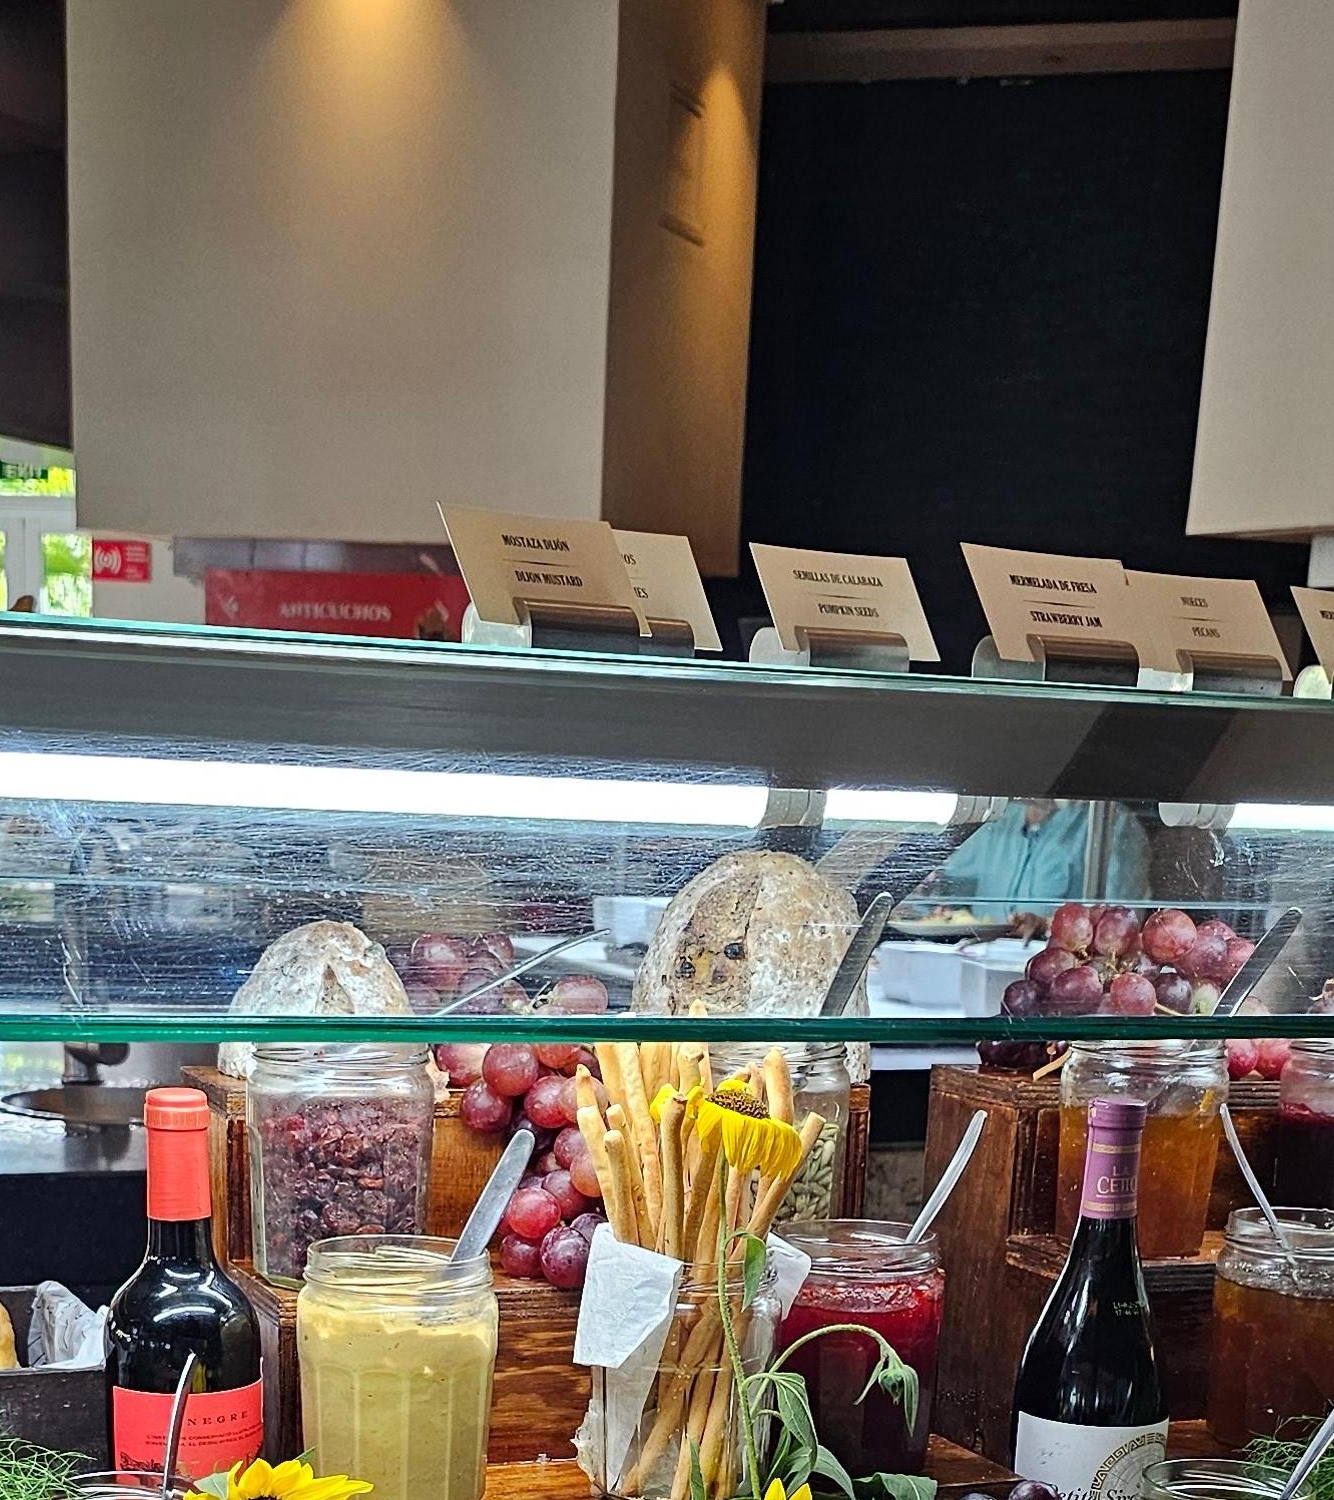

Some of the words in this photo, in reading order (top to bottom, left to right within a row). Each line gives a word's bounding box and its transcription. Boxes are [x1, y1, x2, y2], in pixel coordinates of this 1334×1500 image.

[501, 534, 542, 550] MOSTAZA
[543, 537, 570, 552] DIJÓN
[515, 570, 541, 584] DIJON
[542, 573, 583, 588] MUSTARD
[792, 569, 830, 584] SEMILLAS
[830, 574, 842, 584] DE
[842, 574, 883, 588] CALABAZA
[1009, 574, 1059, 590] MERMELADA
[1058, 580, 1071, 591] DE
[1070, 581, 1097, 593] FRESA
[818, 603, 855, 617] PUMPKIN
[854, 606, 879, 618] SEEDS
[1029, 610, 1084, 626] STRAWBERRY
[1085, 615, 1103, 627] JAM
[187, 1411, 249, 1427] NEGRE
